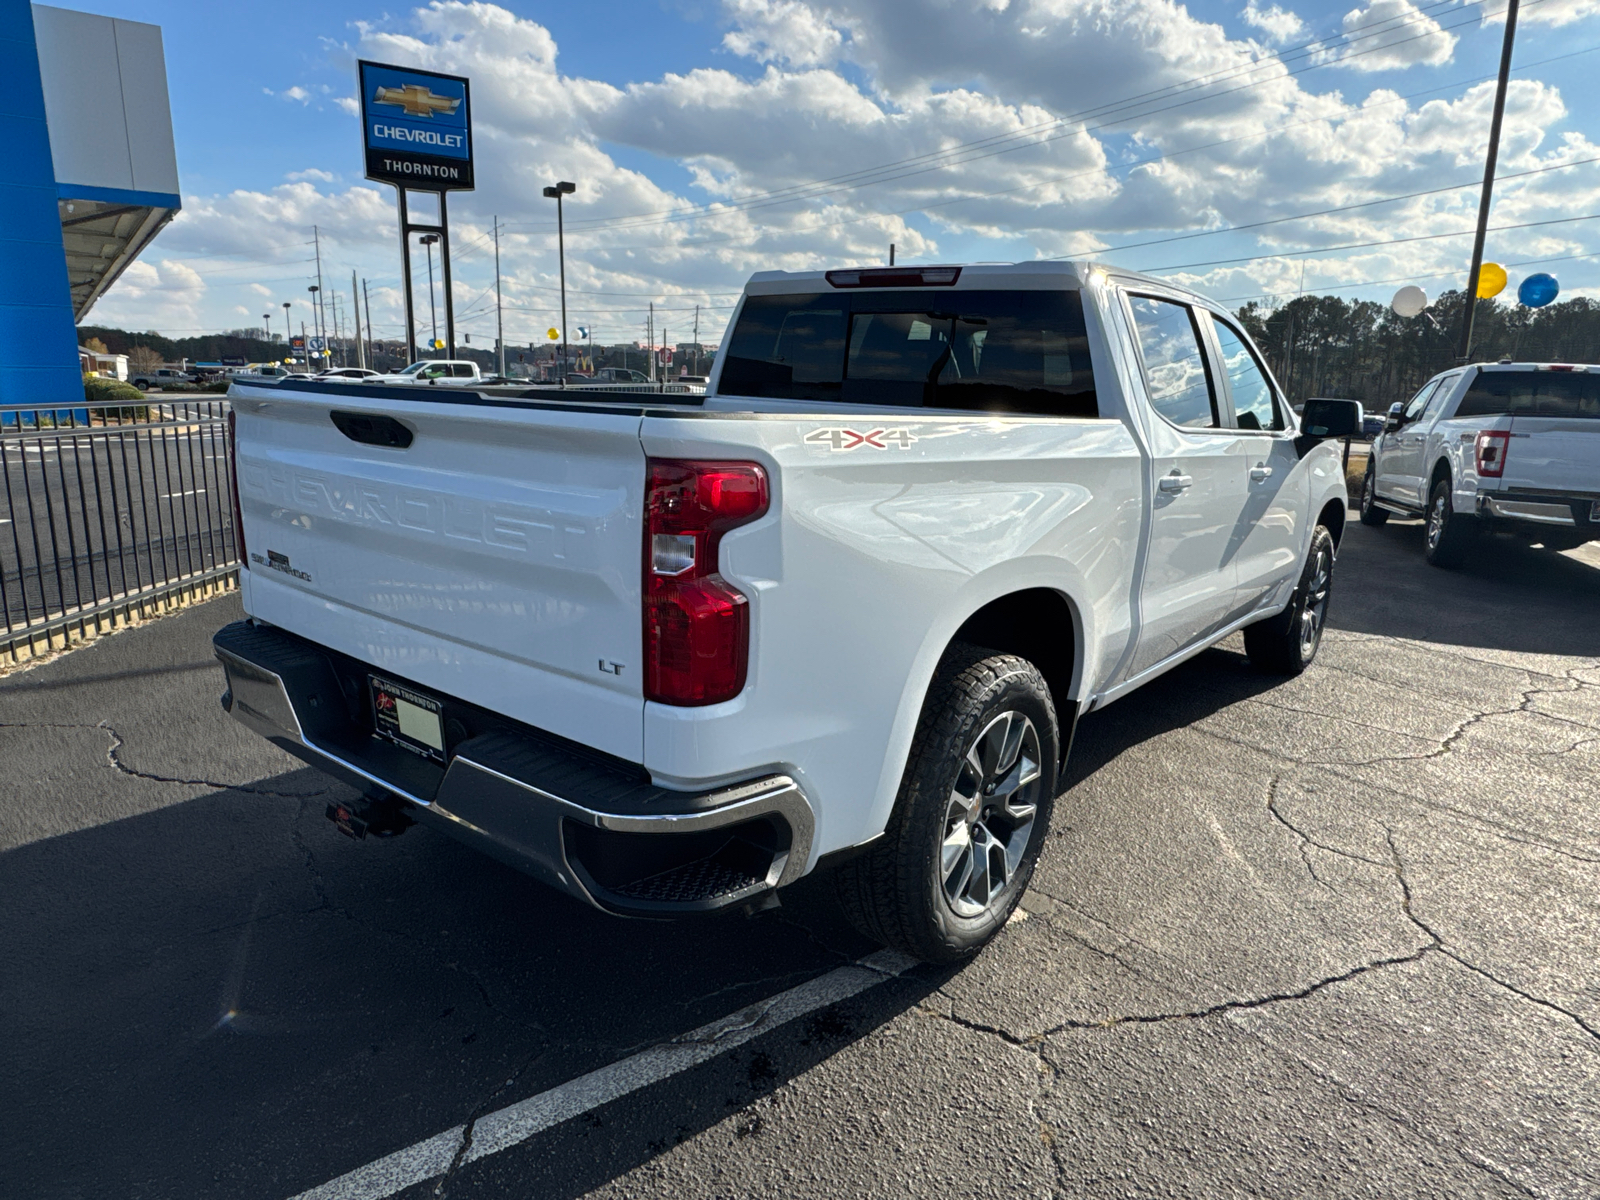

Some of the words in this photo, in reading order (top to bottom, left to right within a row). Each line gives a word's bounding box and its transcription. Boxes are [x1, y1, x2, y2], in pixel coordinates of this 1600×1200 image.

[374, 124, 463, 147] CHEVROLET
[384, 159, 459, 179] THORNTON
[241, 464, 586, 559] CHEVROLET
[599, 659, 625, 675] LT
[401, 690, 437, 711] THORNTON
